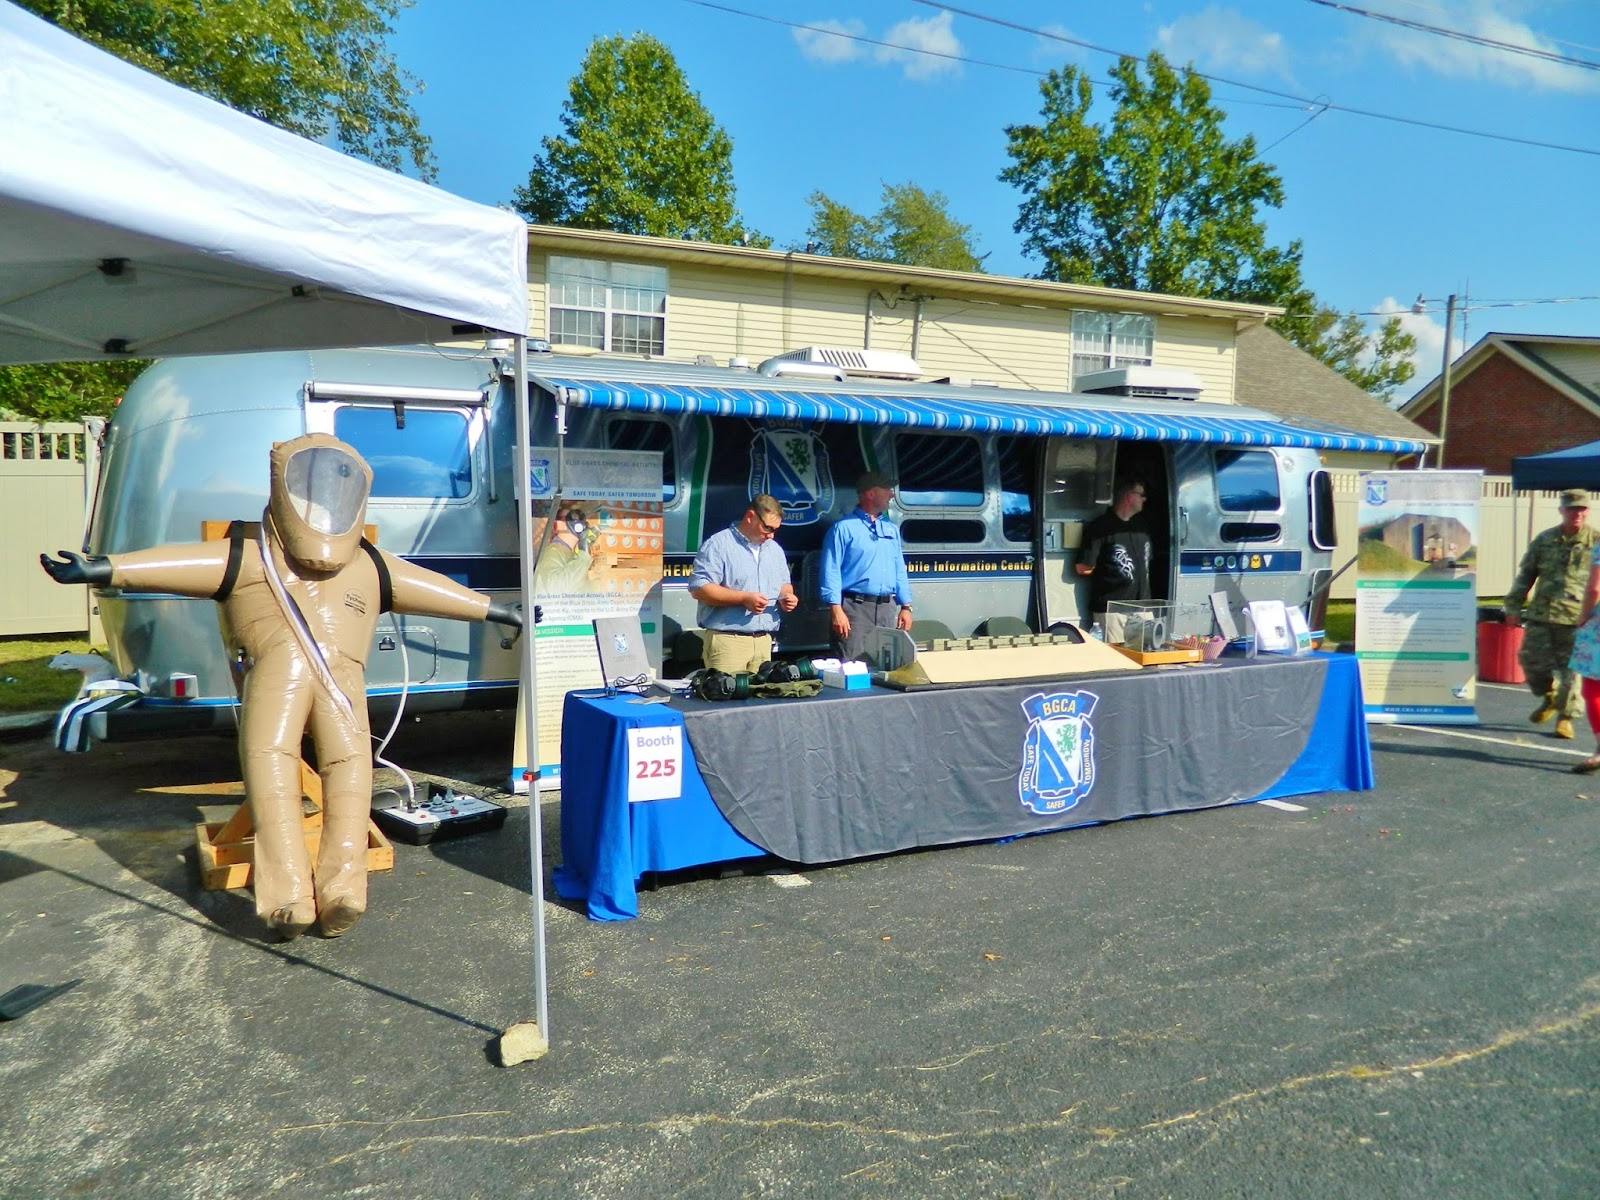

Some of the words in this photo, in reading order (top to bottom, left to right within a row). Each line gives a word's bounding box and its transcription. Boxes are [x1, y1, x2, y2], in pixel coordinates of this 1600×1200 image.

[752, 474, 761, 495] TODA
[934, 560, 998, 572] Information
[1000, 559, 1034, 571] Center
[541, 627, 564, 635] MISSION
[1042, 698, 1076, 716] BGCA
[636, 734, 675, 748] Booth
[636, 758, 676, 779] 225
[1083, 739, 1091, 785] TOMORROW
[1022, 767, 1033, 792] TODAY
[1045, 799, 1066, 810] SAFER
